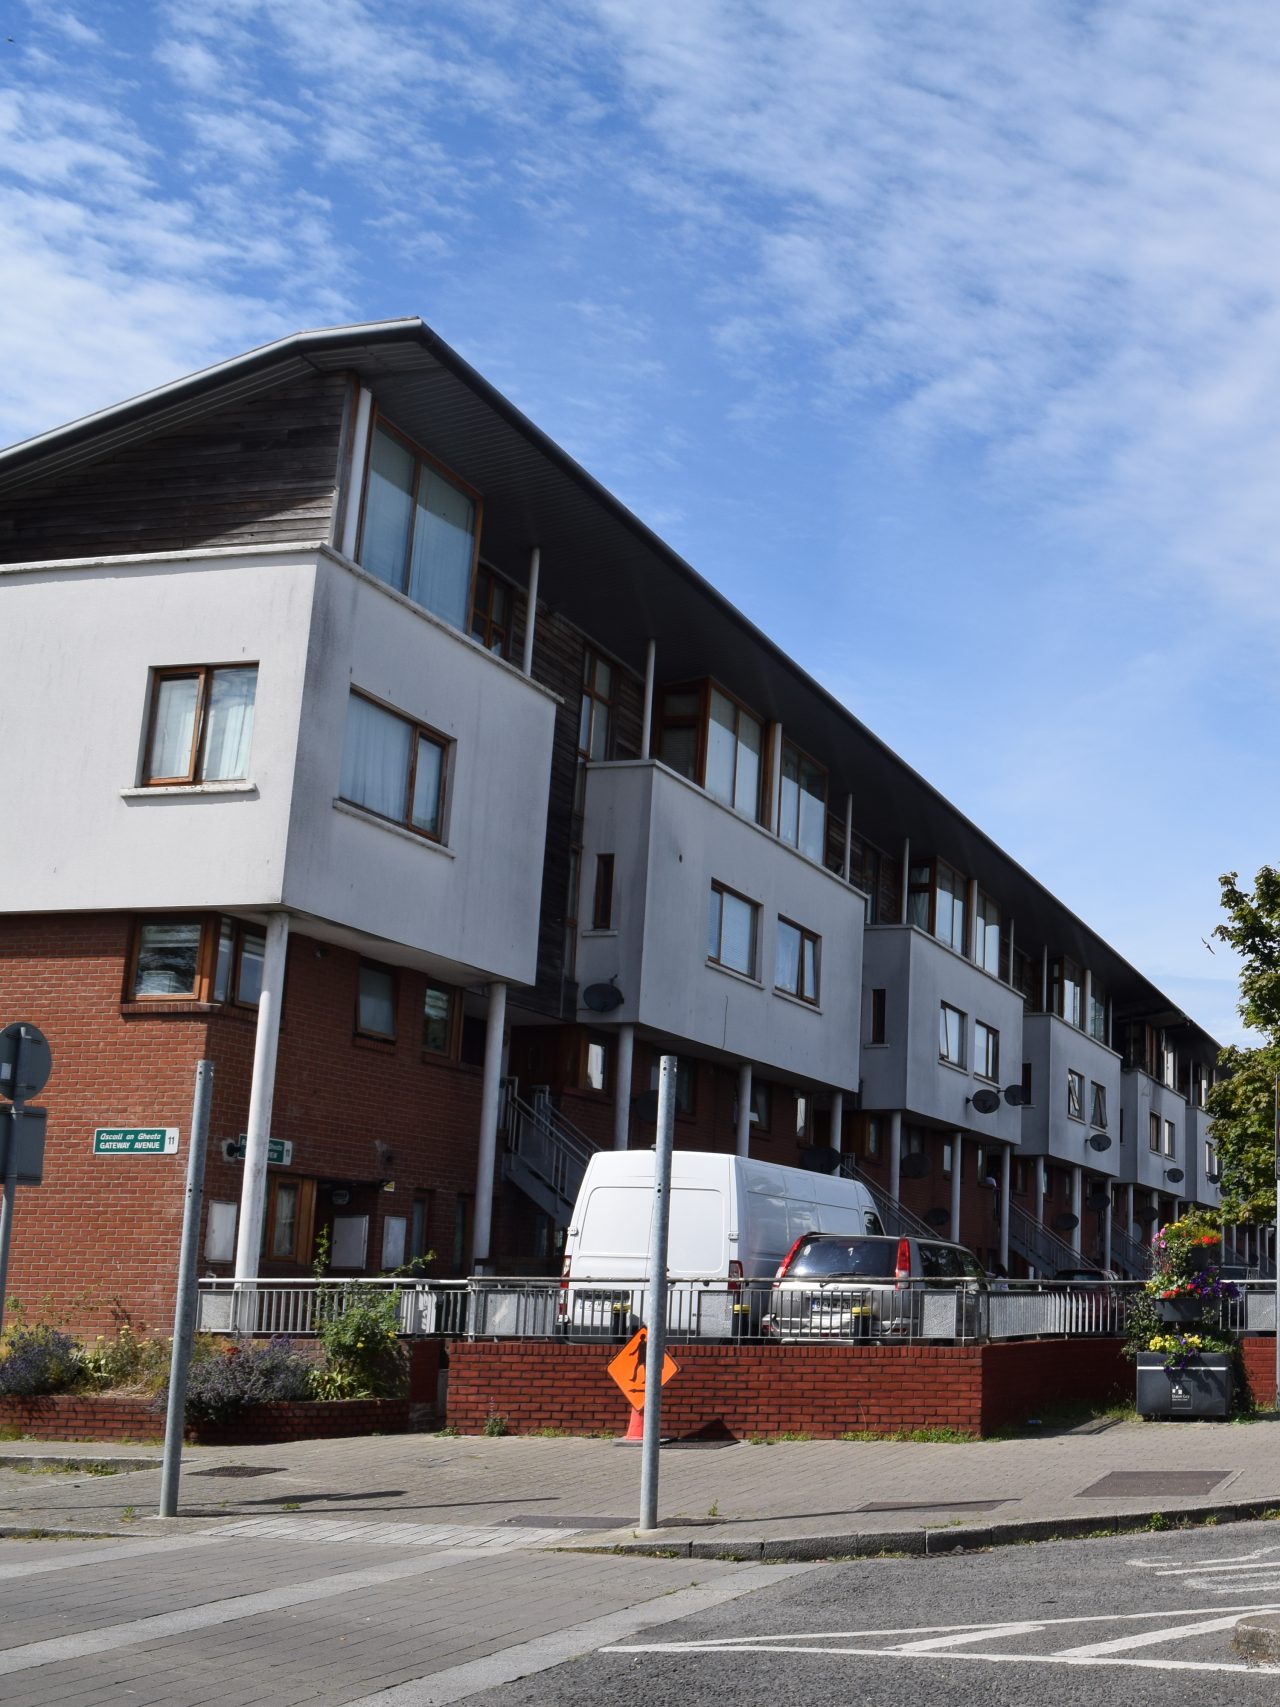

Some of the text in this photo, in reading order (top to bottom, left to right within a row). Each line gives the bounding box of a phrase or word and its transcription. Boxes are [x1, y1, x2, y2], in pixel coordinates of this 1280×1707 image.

[168, 1136, 175, 1145] 11
[99, 1141, 160, 1149] GATEWAY AVENUE
